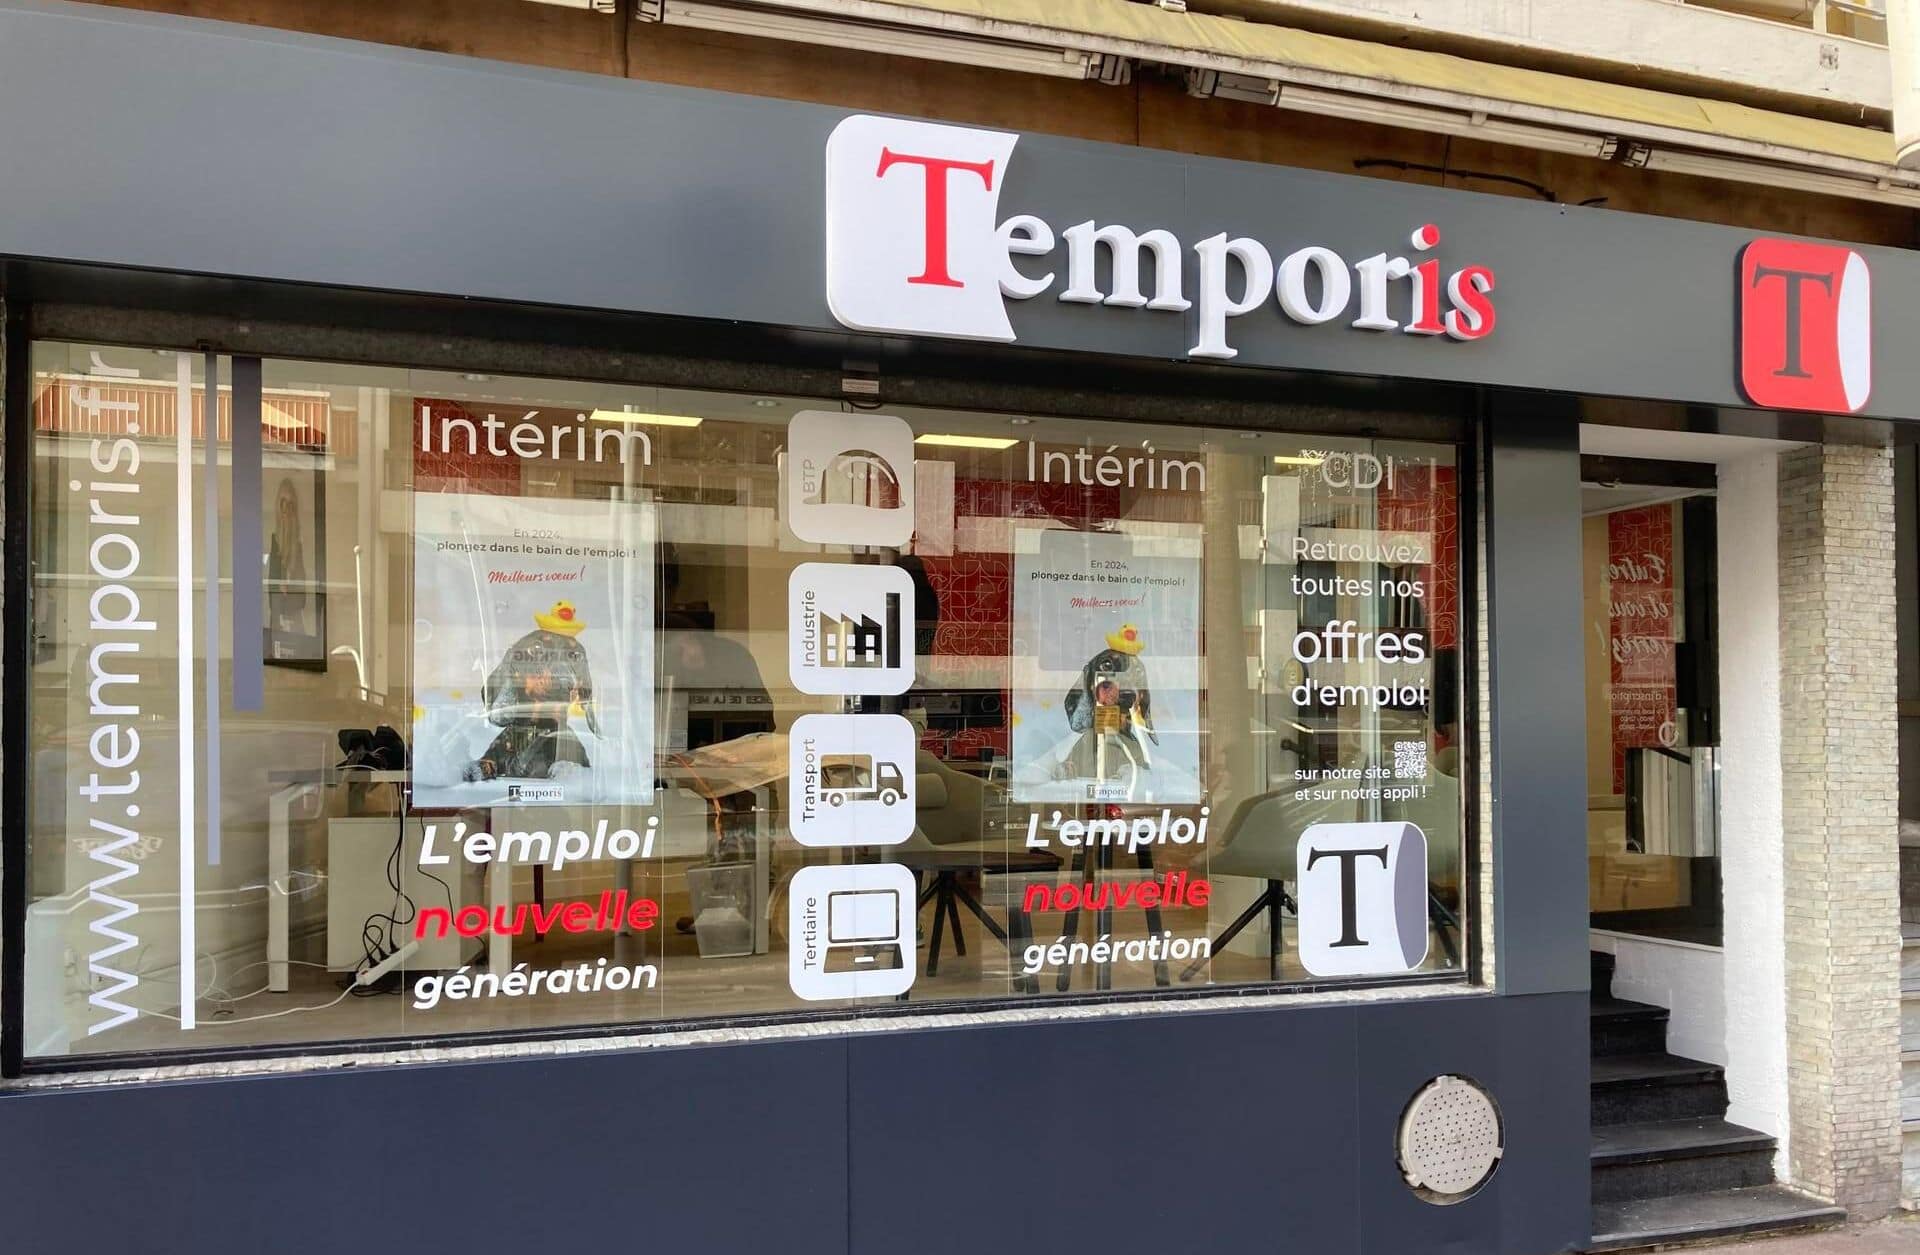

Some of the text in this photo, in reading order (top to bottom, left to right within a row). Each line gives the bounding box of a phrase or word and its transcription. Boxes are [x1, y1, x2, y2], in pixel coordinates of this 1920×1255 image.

[876, 146, 1495, 358] Temporis
[1753, 262, 1834, 379] T
[422, 405, 652, 466] Intérim
[802, 458, 816, 494] BTP
[1028, 440, 1206, 492] Intérim
[1321, 452, 1394, 491] CDI
[489, 542, 519, 553] dans
[522, 544, 534, 554] le
[536, 545, 562, 555] bain
[565, 546, 580, 556] de
[1090, 559, 1103, 569] En
[1291, 536, 1425, 564] Retrouvez
[1031, 570, 1070, 582] plongez
[1072, 573, 1095, 581] dans
[1097, 573, 1106, 583] le
[1108, 574, 1128, 583] bain
[1130, 575, 1143, 584] de
[1290, 574, 1425, 598] toutes nos
[801, 589, 816, 667] Industrie
[1292, 620, 1425, 665] offres
[70, 352, 157, 1035] www.temporis.fr
[1291, 677, 1425, 713] d'emploi
[509, 785, 562, 800] Temporis
[802, 737, 818, 823] Transport
[1294, 765, 1391, 780] sur notre site
[1295, 788, 1310, 801] et
[1313, 789, 1337, 801] sur
[1341, 787, 1380, 799] notre
[1383, 784, 1419, 802] appli
[1022, 869, 1213, 913] nouvelle
[1306, 843, 1389, 949] T
[414, 888, 659, 942] nouvelle
[803, 896, 818, 970] Tertiaire
[1022, 930, 1212, 974] génération
[412, 956, 658, 1010] génération
